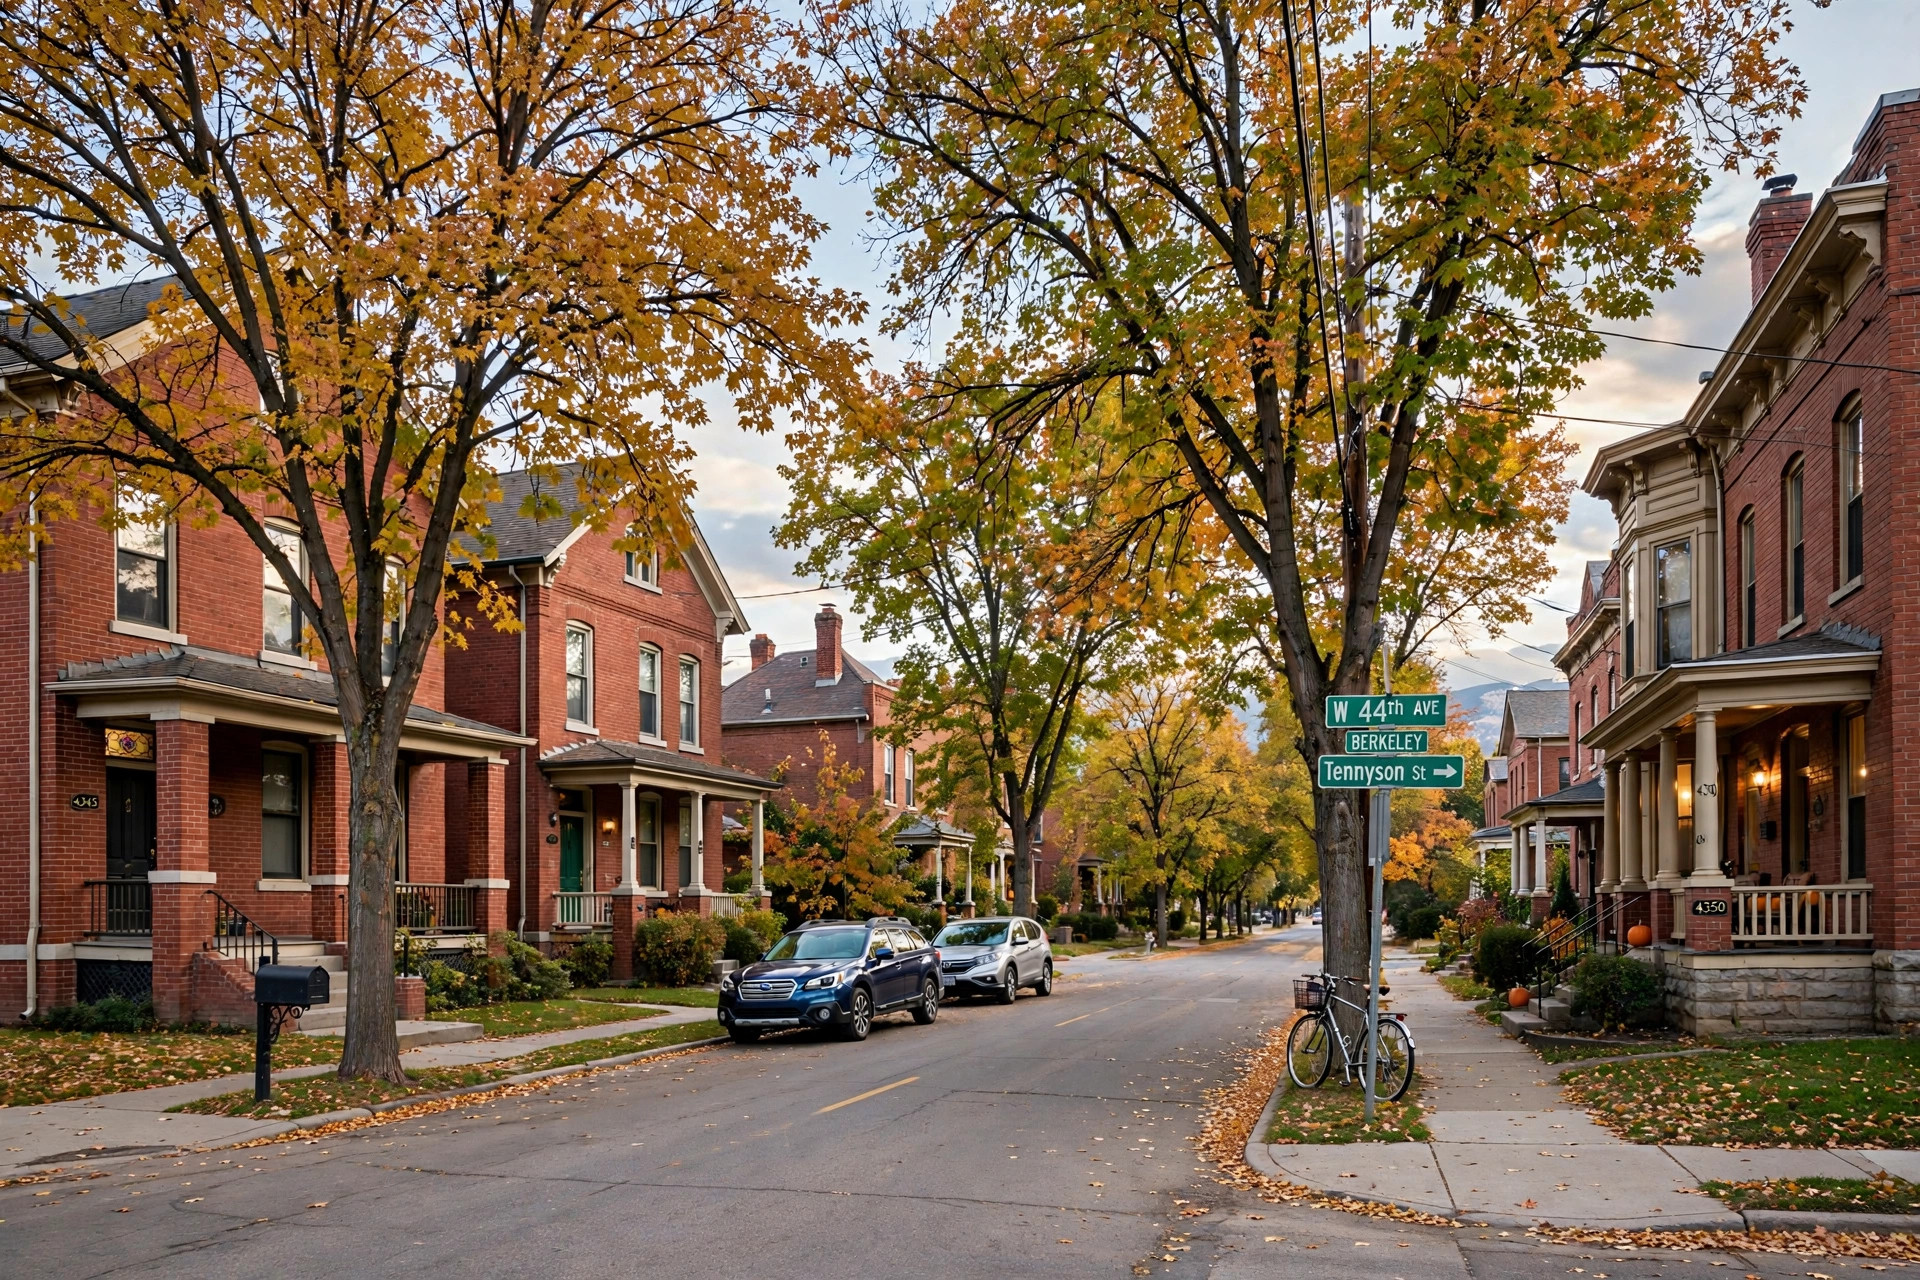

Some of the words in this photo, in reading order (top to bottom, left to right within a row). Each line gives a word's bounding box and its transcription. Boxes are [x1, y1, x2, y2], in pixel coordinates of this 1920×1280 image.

[1333, 700, 1349, 723] W
[1358, 699, 1404, 723] 44th
[1413, 700, 1440, 716] AVE
[1351, 733, 1423, 751] BERKELEY
[1323, 761, 1404, 786] Tennyson
[1412, 764, 1427, 781] St
[1695, 901, 1726, 914] 4350
